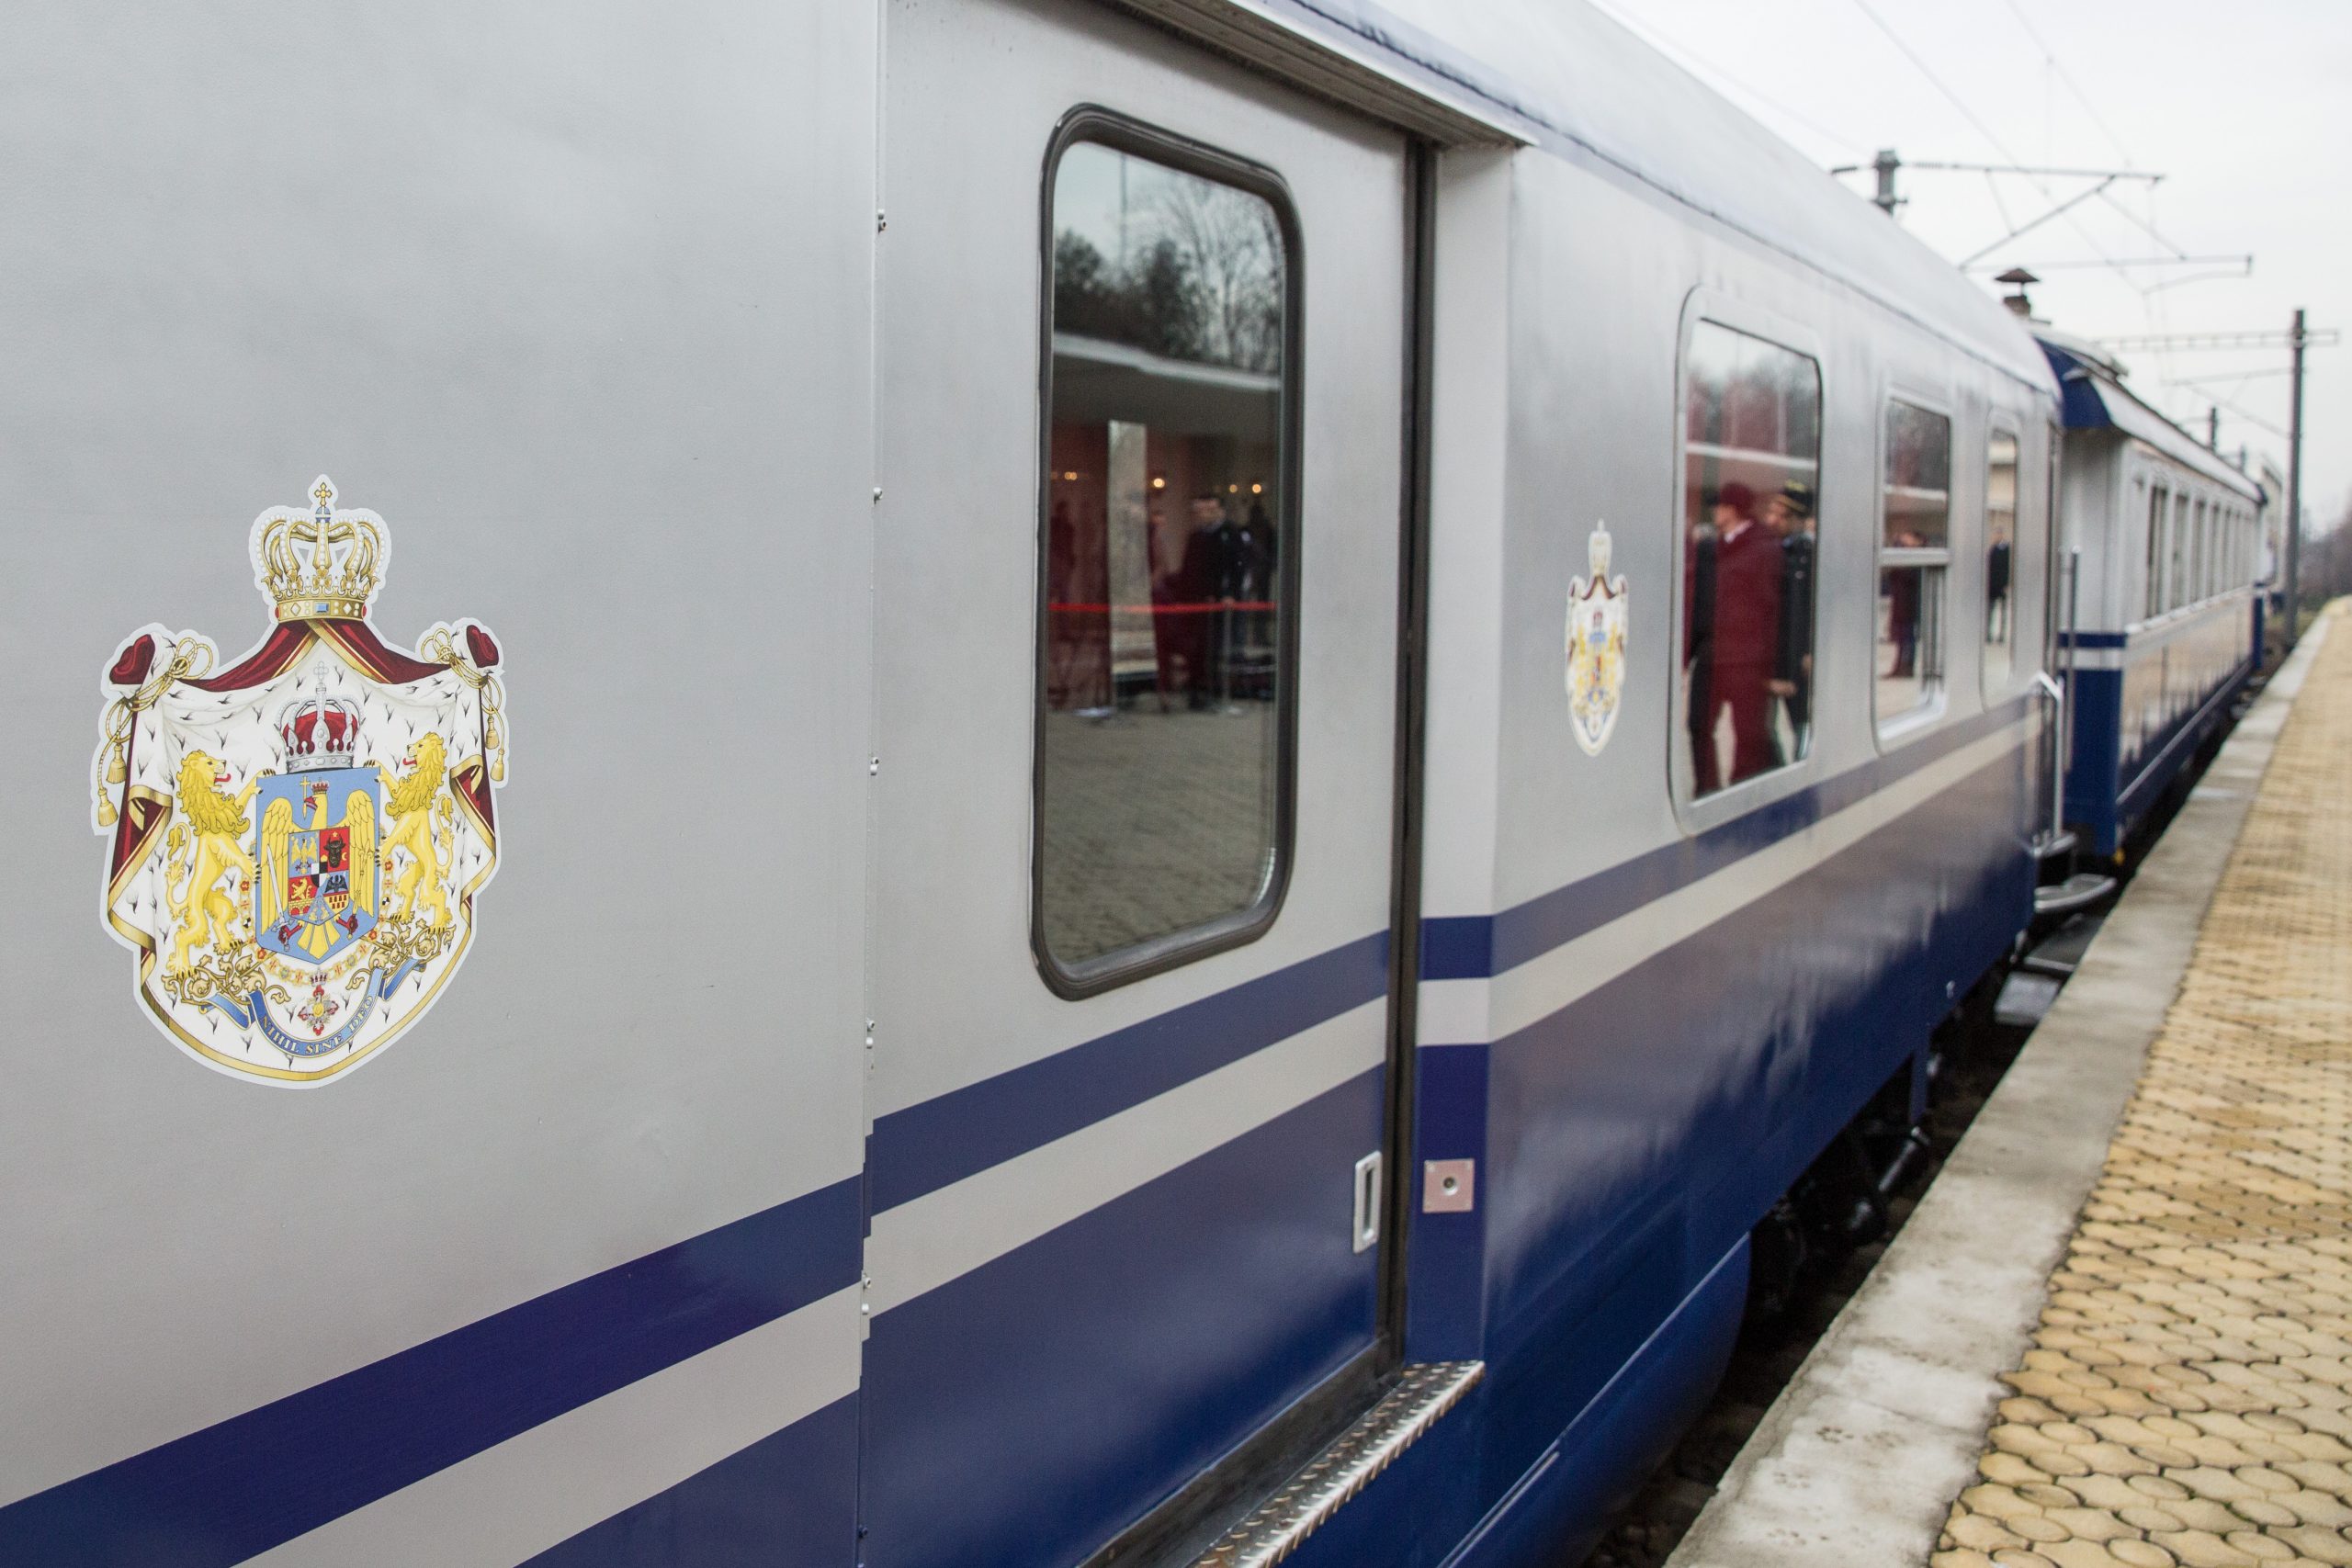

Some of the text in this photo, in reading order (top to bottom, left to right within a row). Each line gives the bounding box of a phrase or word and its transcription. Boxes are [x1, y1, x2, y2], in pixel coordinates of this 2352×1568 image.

[261, 995, 374, 1055] NIHIL SINE DEO
